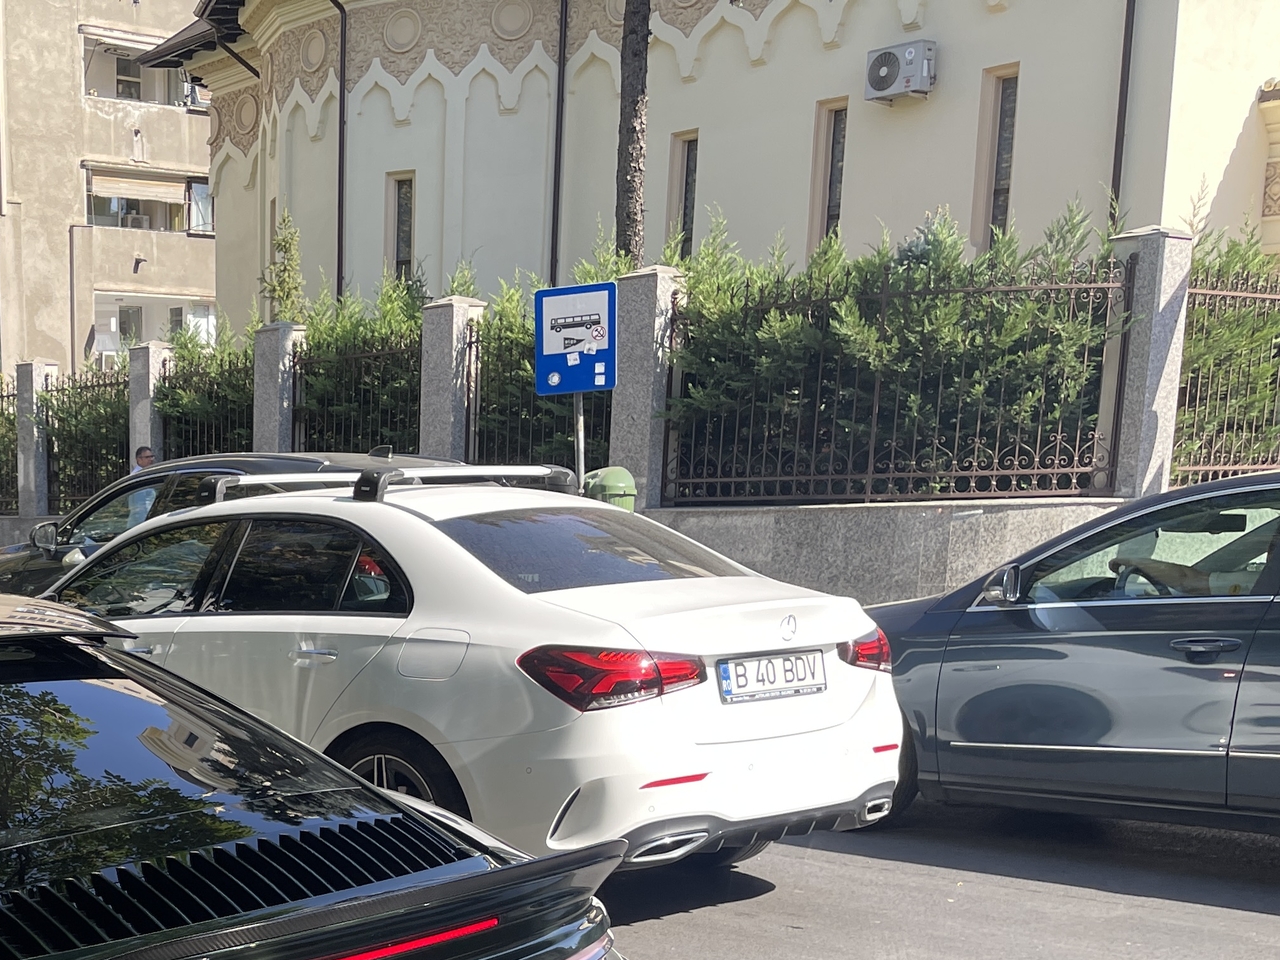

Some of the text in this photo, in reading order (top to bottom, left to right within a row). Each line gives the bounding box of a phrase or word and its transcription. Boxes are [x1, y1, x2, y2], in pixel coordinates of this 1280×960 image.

[734, 655, 816, 689] B 40 BDV
